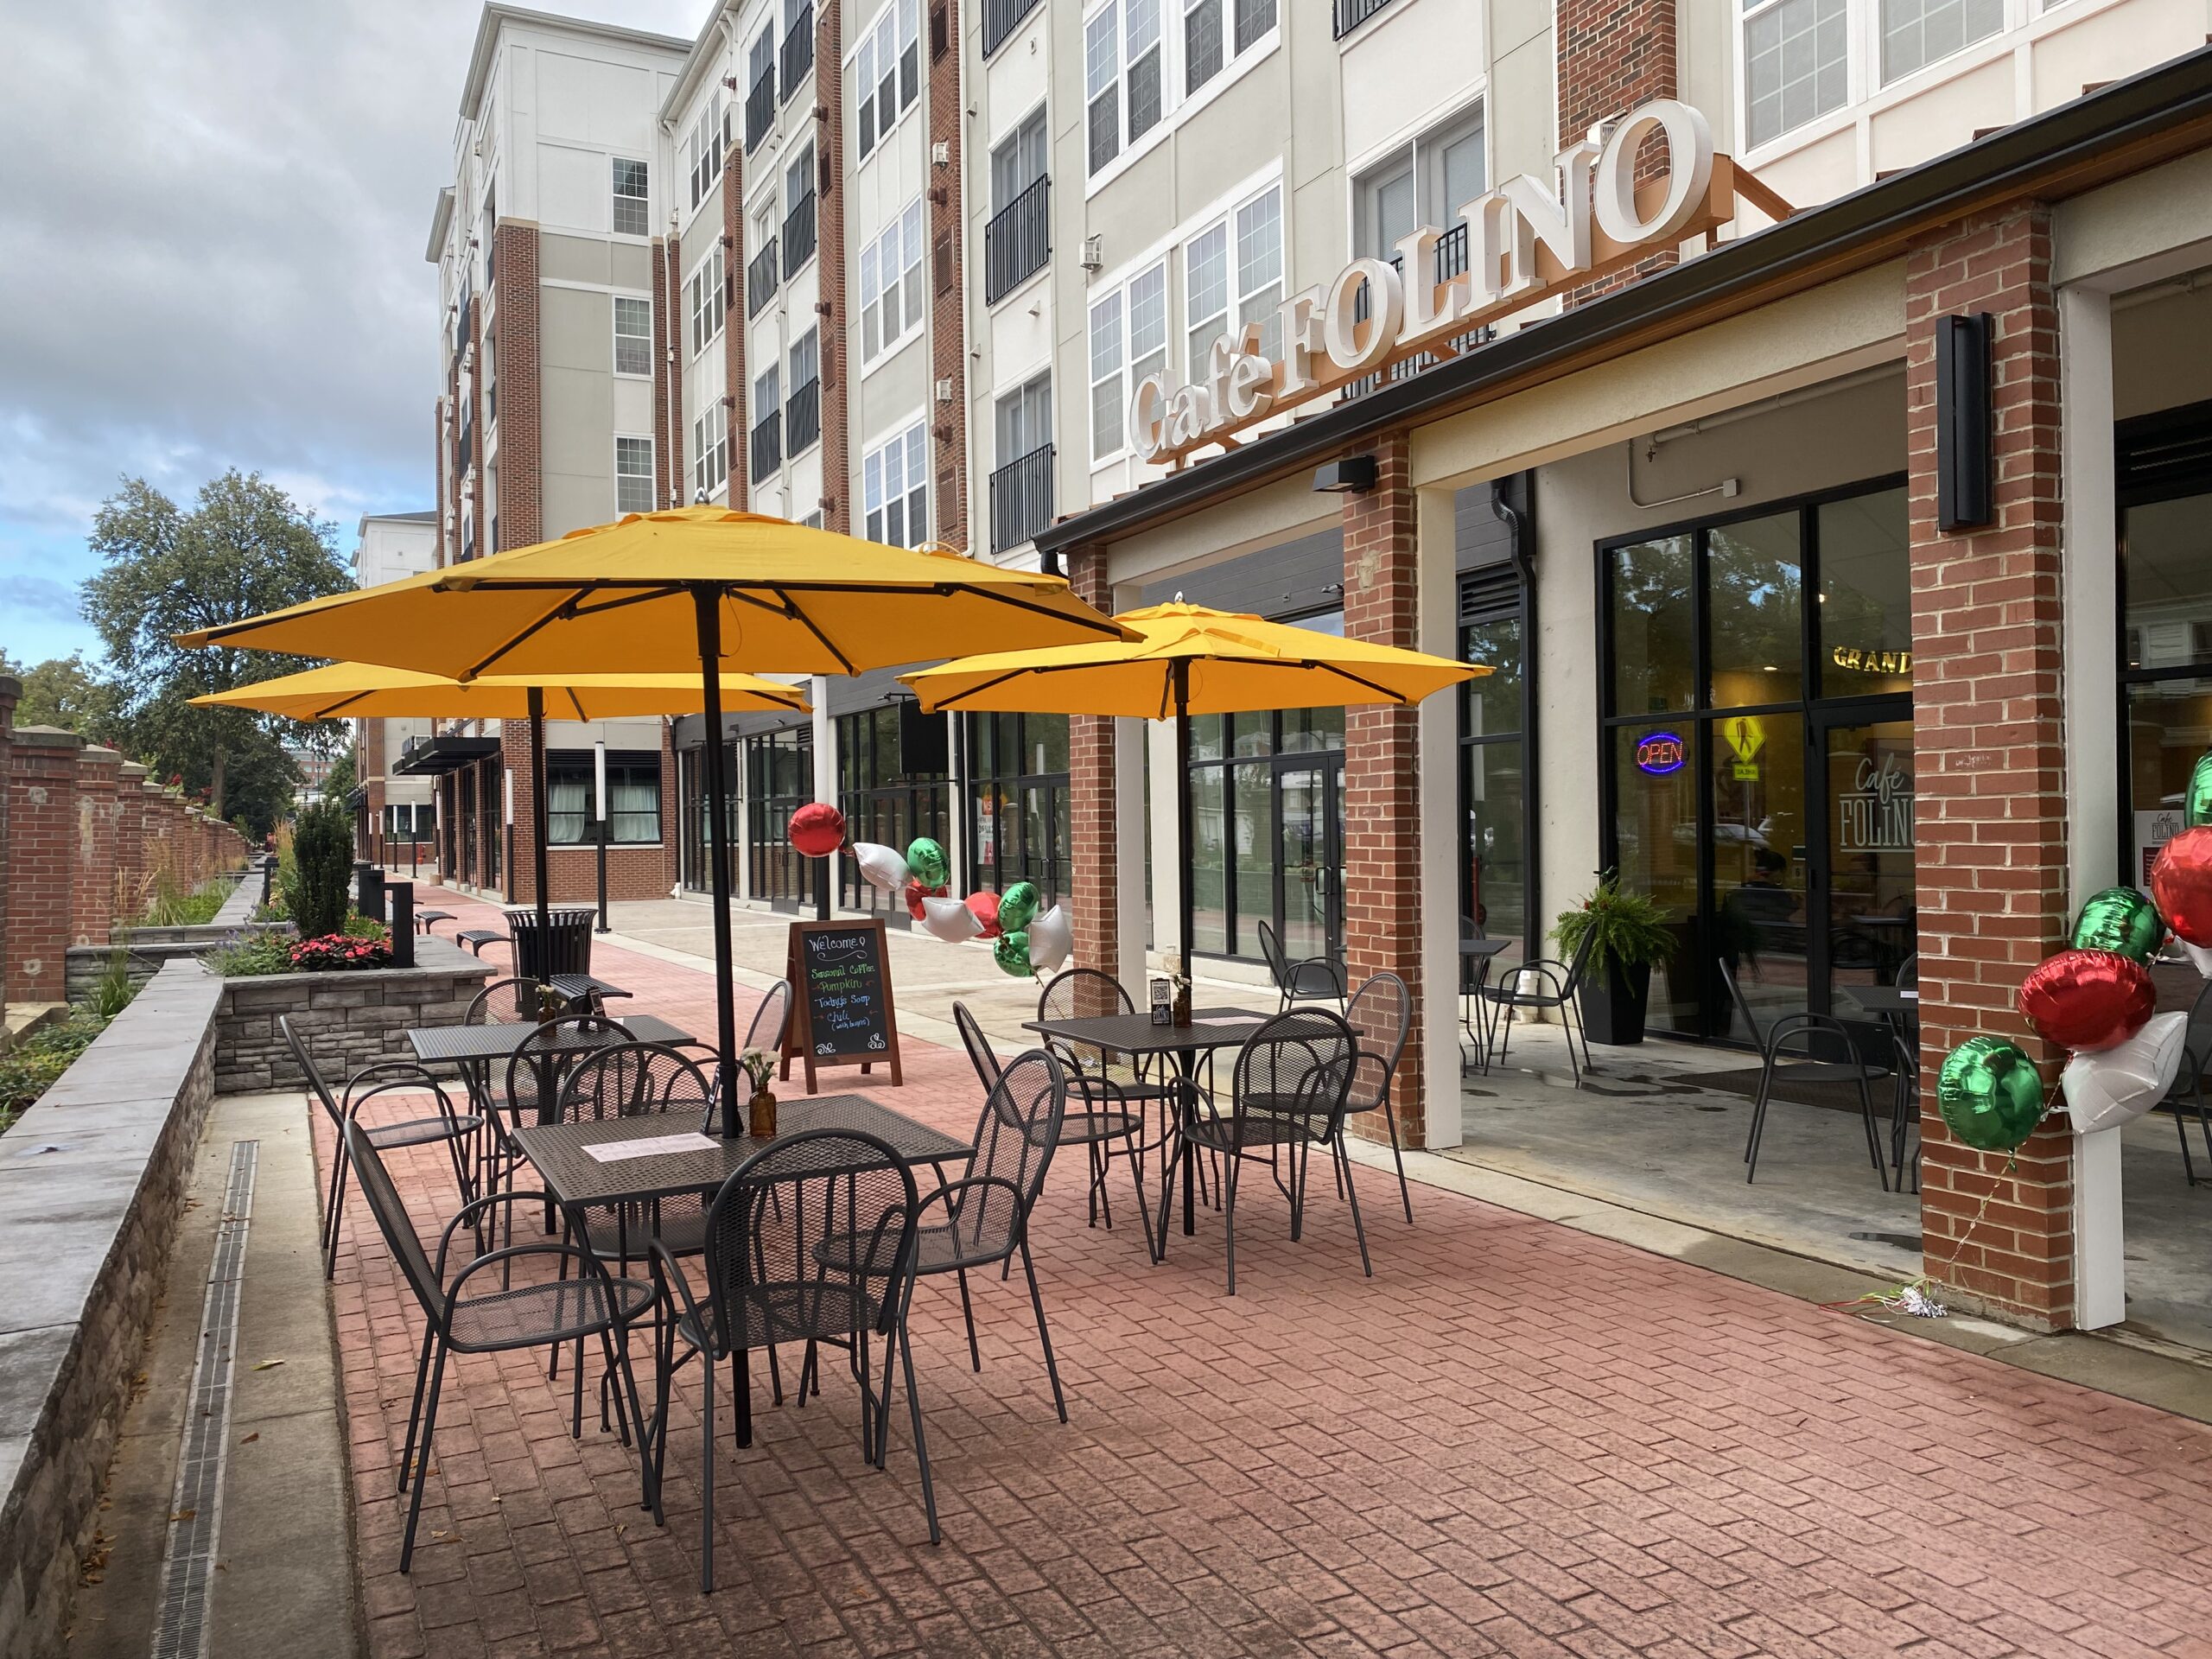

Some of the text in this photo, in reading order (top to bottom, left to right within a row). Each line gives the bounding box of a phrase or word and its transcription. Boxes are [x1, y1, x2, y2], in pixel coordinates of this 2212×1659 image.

[1129, 99, 1713, 460] Café FOLINO
[1834, 646, 1913, 673] GRAND
[1637, 741, 1682, 765] OPEN
[1855, 753, 1904, 804] Café
[819, 978, 862, 994] Pumpkin
[850, 995, 870, 1006] Soup
